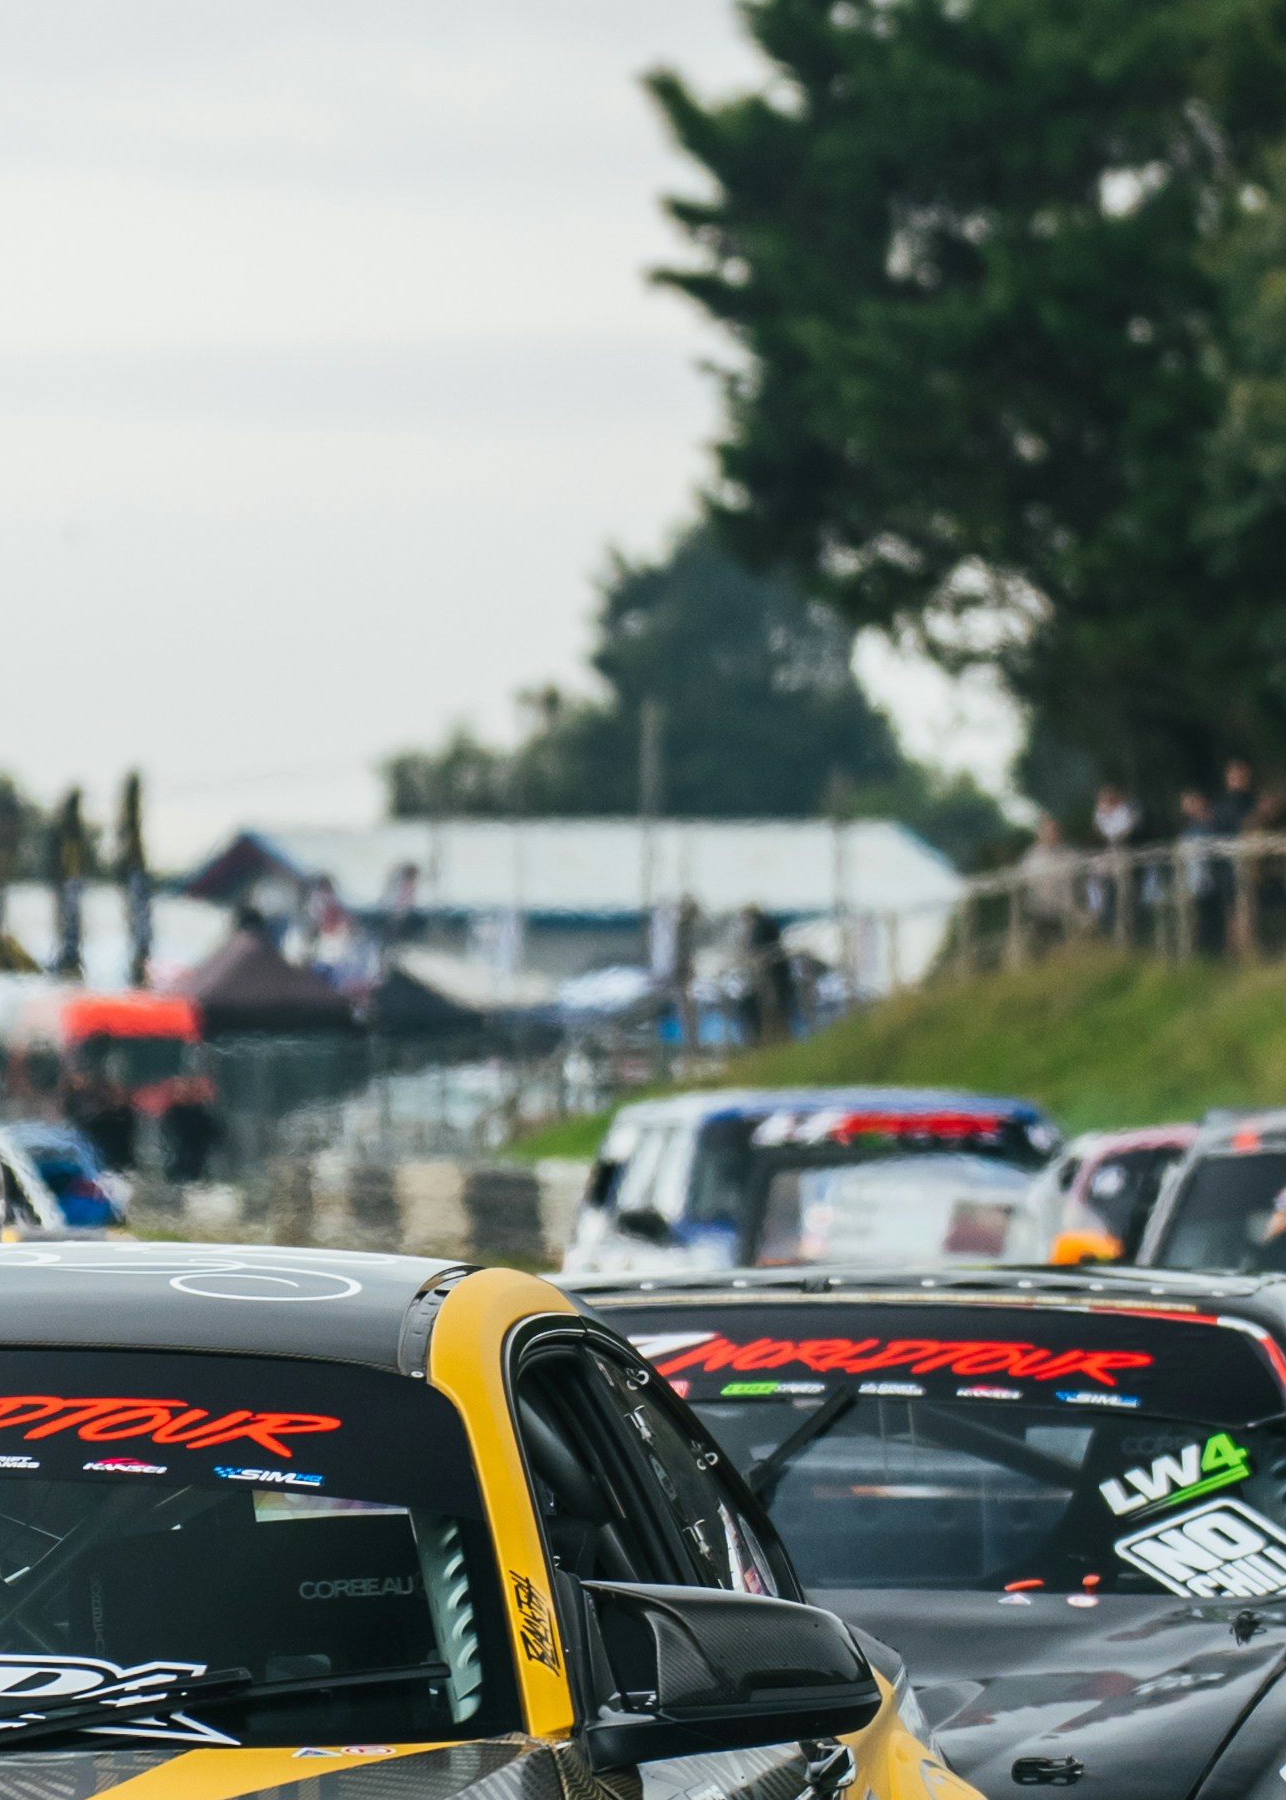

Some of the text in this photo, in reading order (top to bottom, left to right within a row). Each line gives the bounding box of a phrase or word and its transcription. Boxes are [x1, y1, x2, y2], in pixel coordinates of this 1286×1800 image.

[658, 1336, 1153, 1387] WORLDTOUR
[82, 1461, 168, 1474] KANSEI
[1098, 1432, 1248, 1516] LW4
[1130, 1511, 1266, 1583] NO
[298, 1575, 414, 1601] CORBEAU
